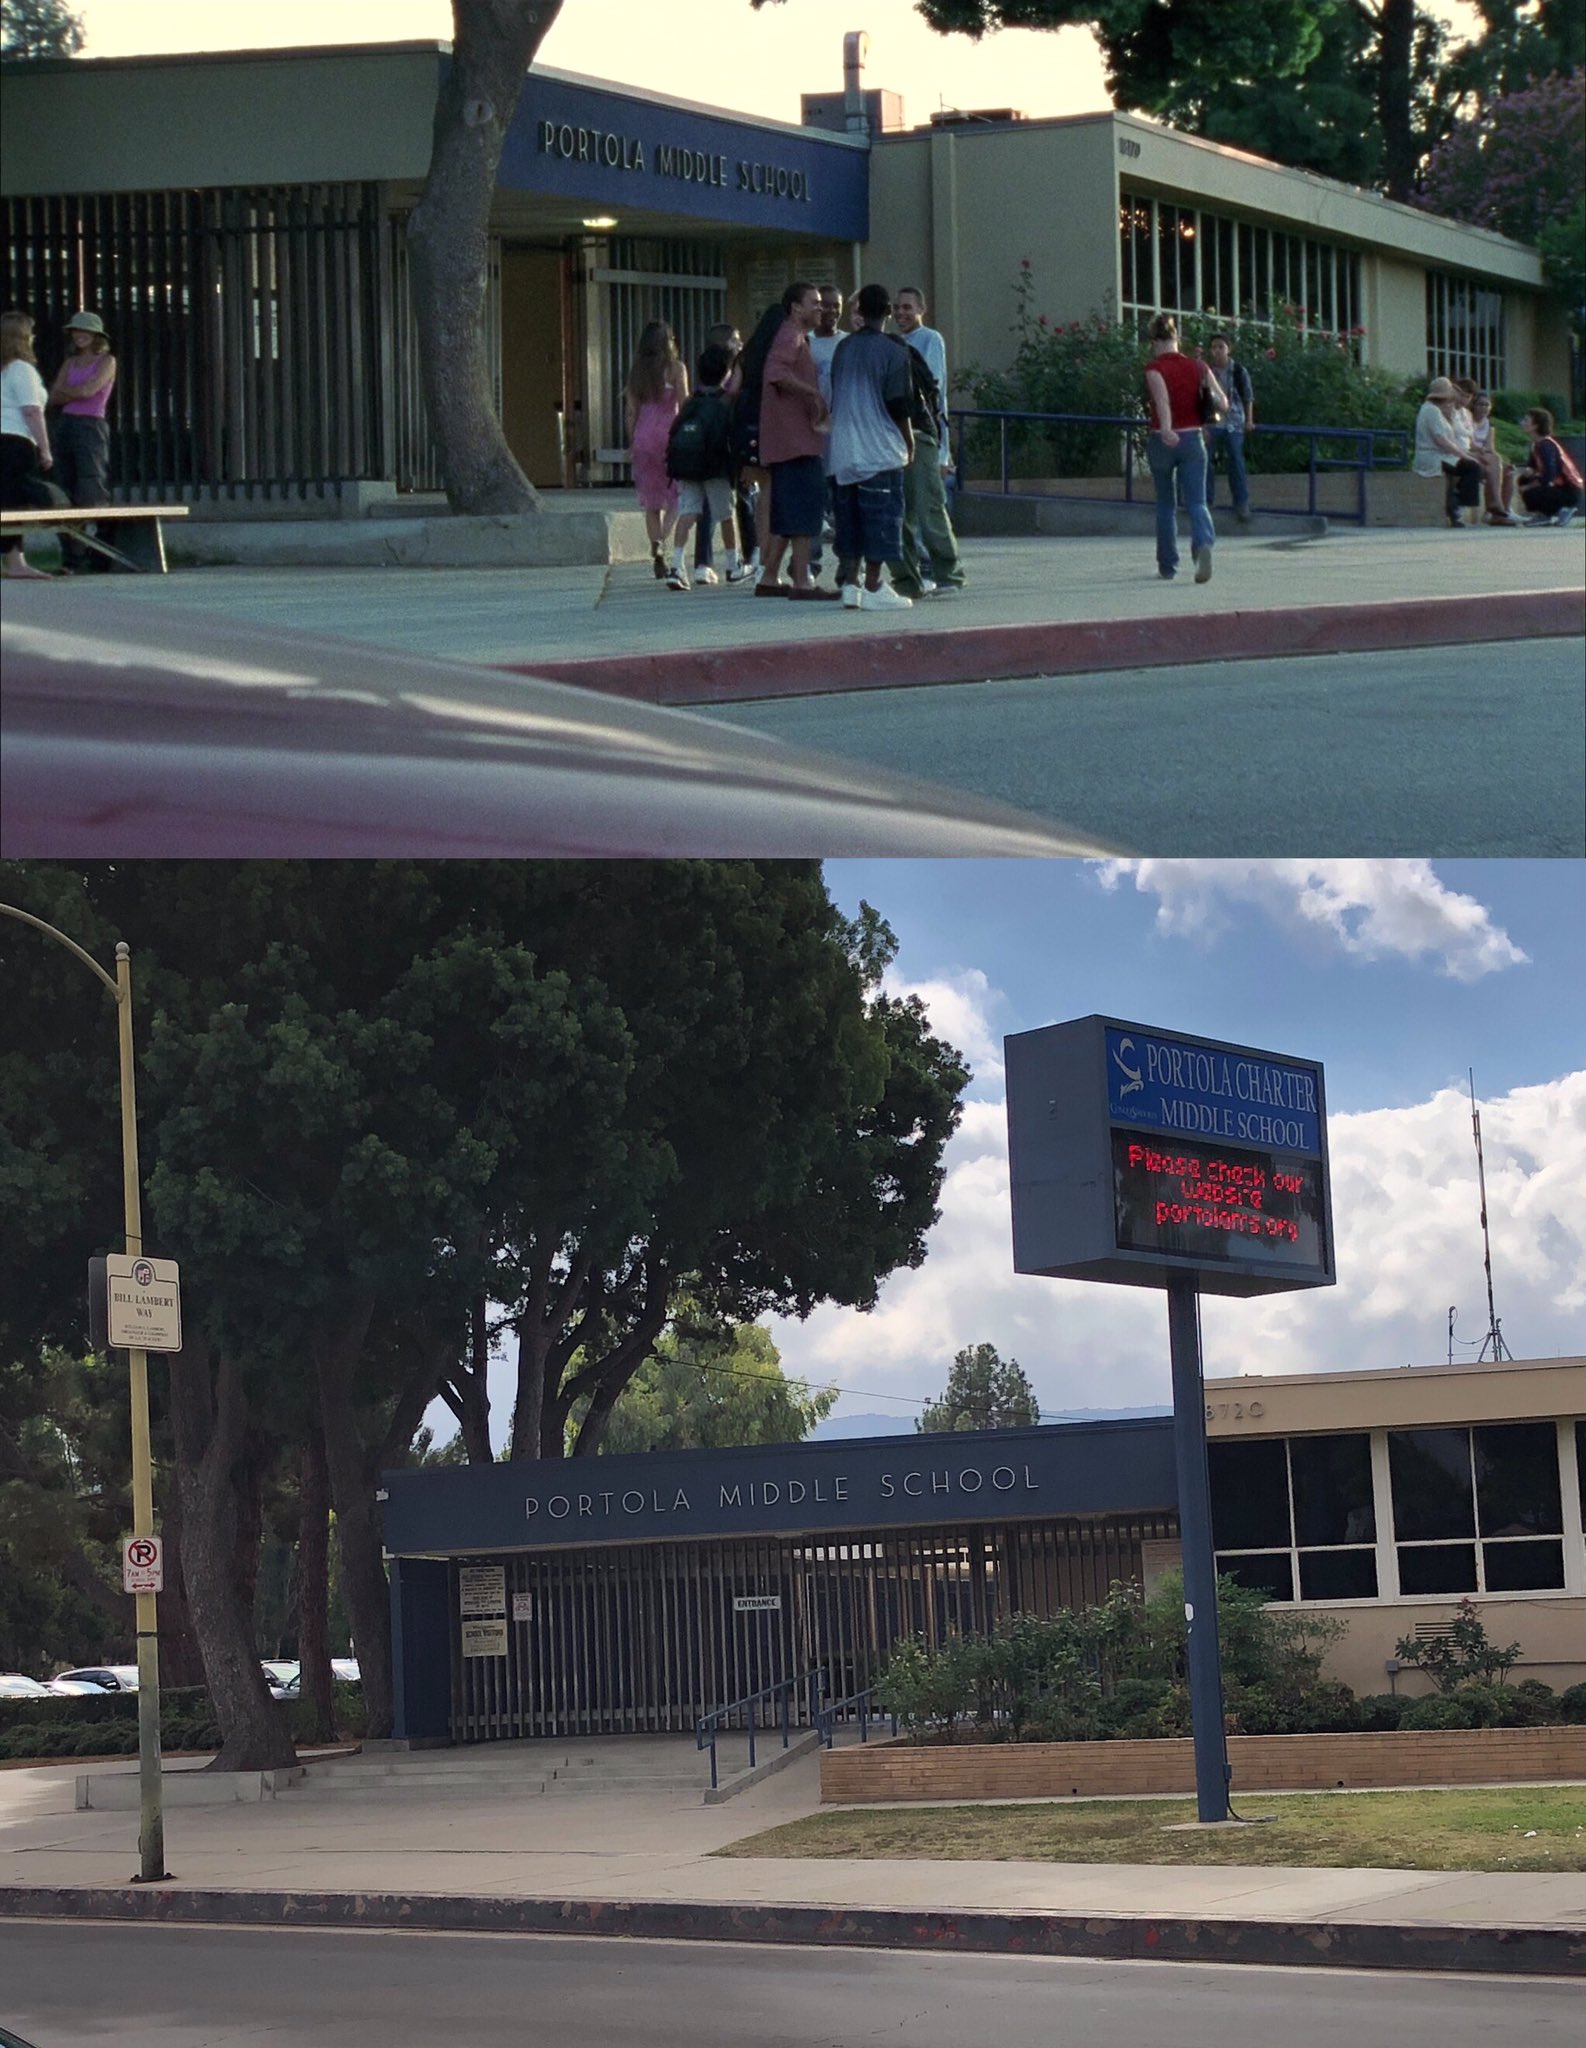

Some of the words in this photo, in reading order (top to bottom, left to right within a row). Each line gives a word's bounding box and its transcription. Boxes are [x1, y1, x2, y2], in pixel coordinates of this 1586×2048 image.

[544, 120, 646, 172] PORTOLA
[659, 147, 728, 187] MIDDLE
[740, 159, 812, 201] SCHOOL
[1146, 1043, 1233, 1097] PORTOLA
[1235, 1062, 1317, 1113] CHARTER
[1160, 1097, 1234, 1137] MIDDLE
[1237, 1111, 1310, 1150] SCHOOL
[1128, 1145, 1200, 1179] Please
[1207, 1160, 1267, 1188] check
[1272, 1173, 1304, 1193] our
[114, 1293, 133, 1303] BILL
[136, 1295, 174, 1307] LAMBERT
[136, 1308, 153, 1318] WAY
[524, 1487, 691, 1521] PORTOLA
[718, 1476, 850, 1508] MIDDLE
[880, 1464, 1040, 1498] SCHOOL
[737, 1598, 777, 1608] ENTRANCE
